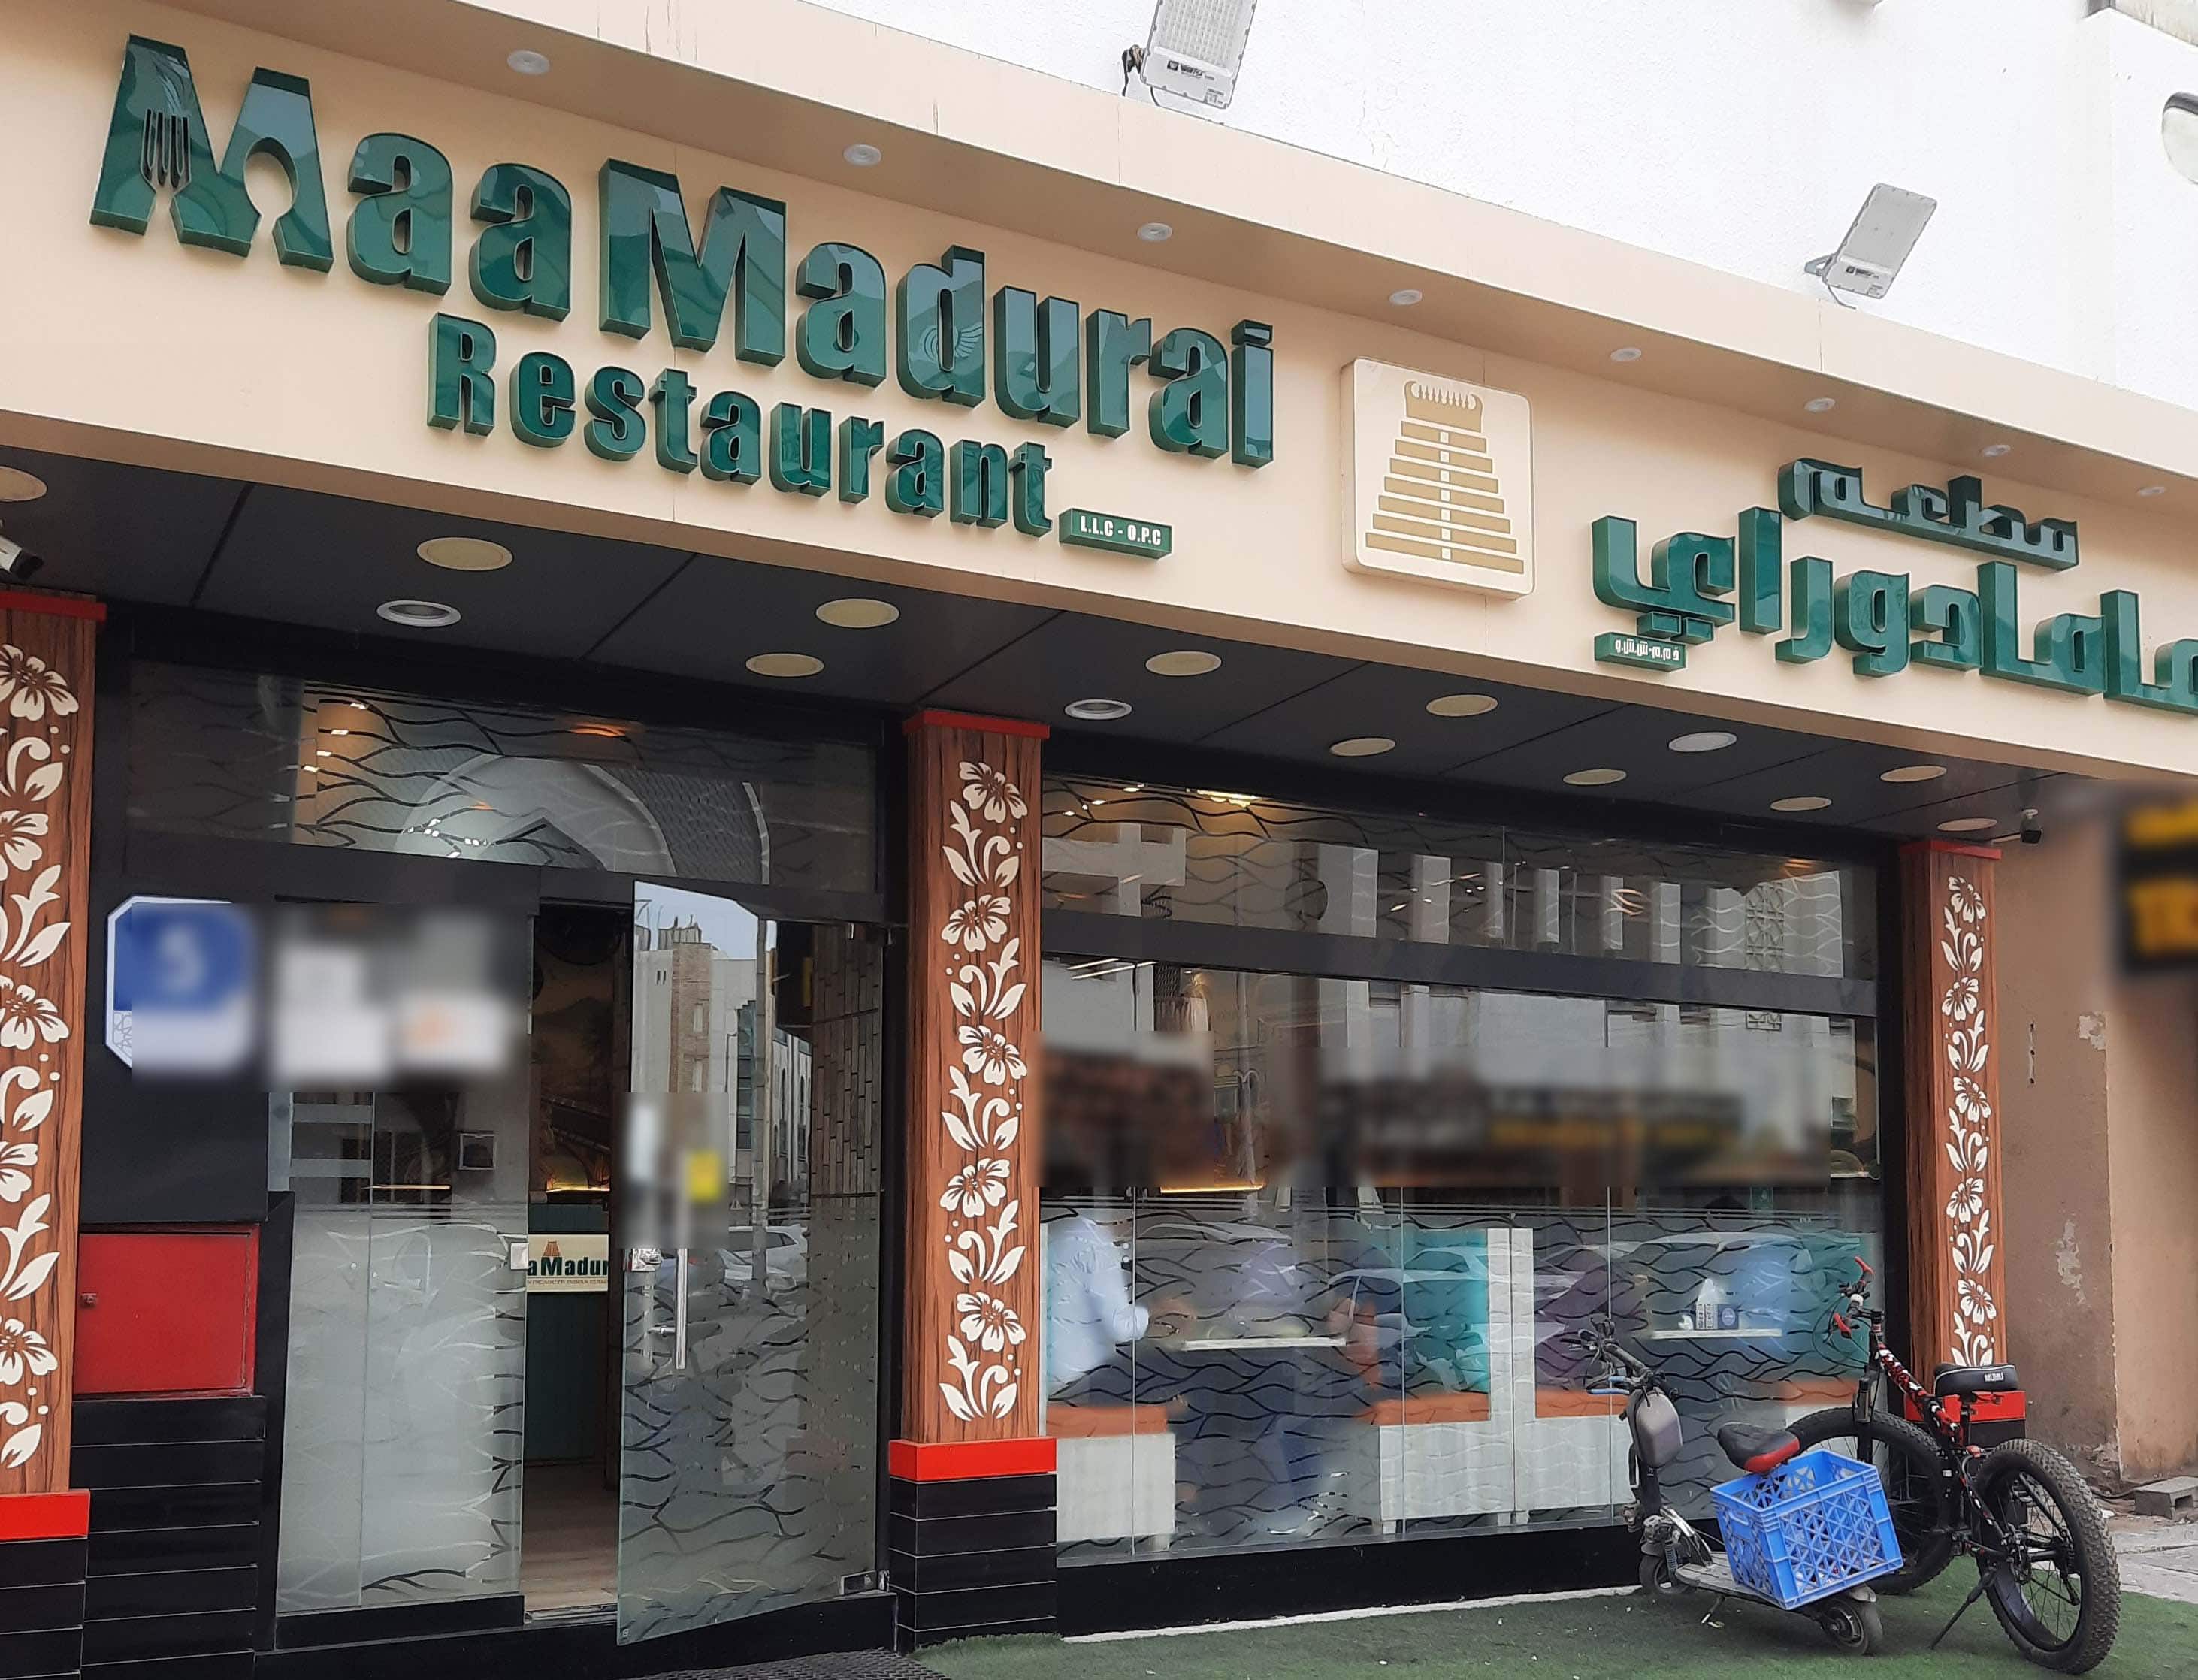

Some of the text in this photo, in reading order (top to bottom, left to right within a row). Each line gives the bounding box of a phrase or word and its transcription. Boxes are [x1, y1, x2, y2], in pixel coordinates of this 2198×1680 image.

[426, 311, 1053, 538] Restaurant
[1080, 515, 1114, 537] L.L.C
[1127, 524, 1162, 545] O.P.C
[1778, 457, 2080, 571] مطعم
